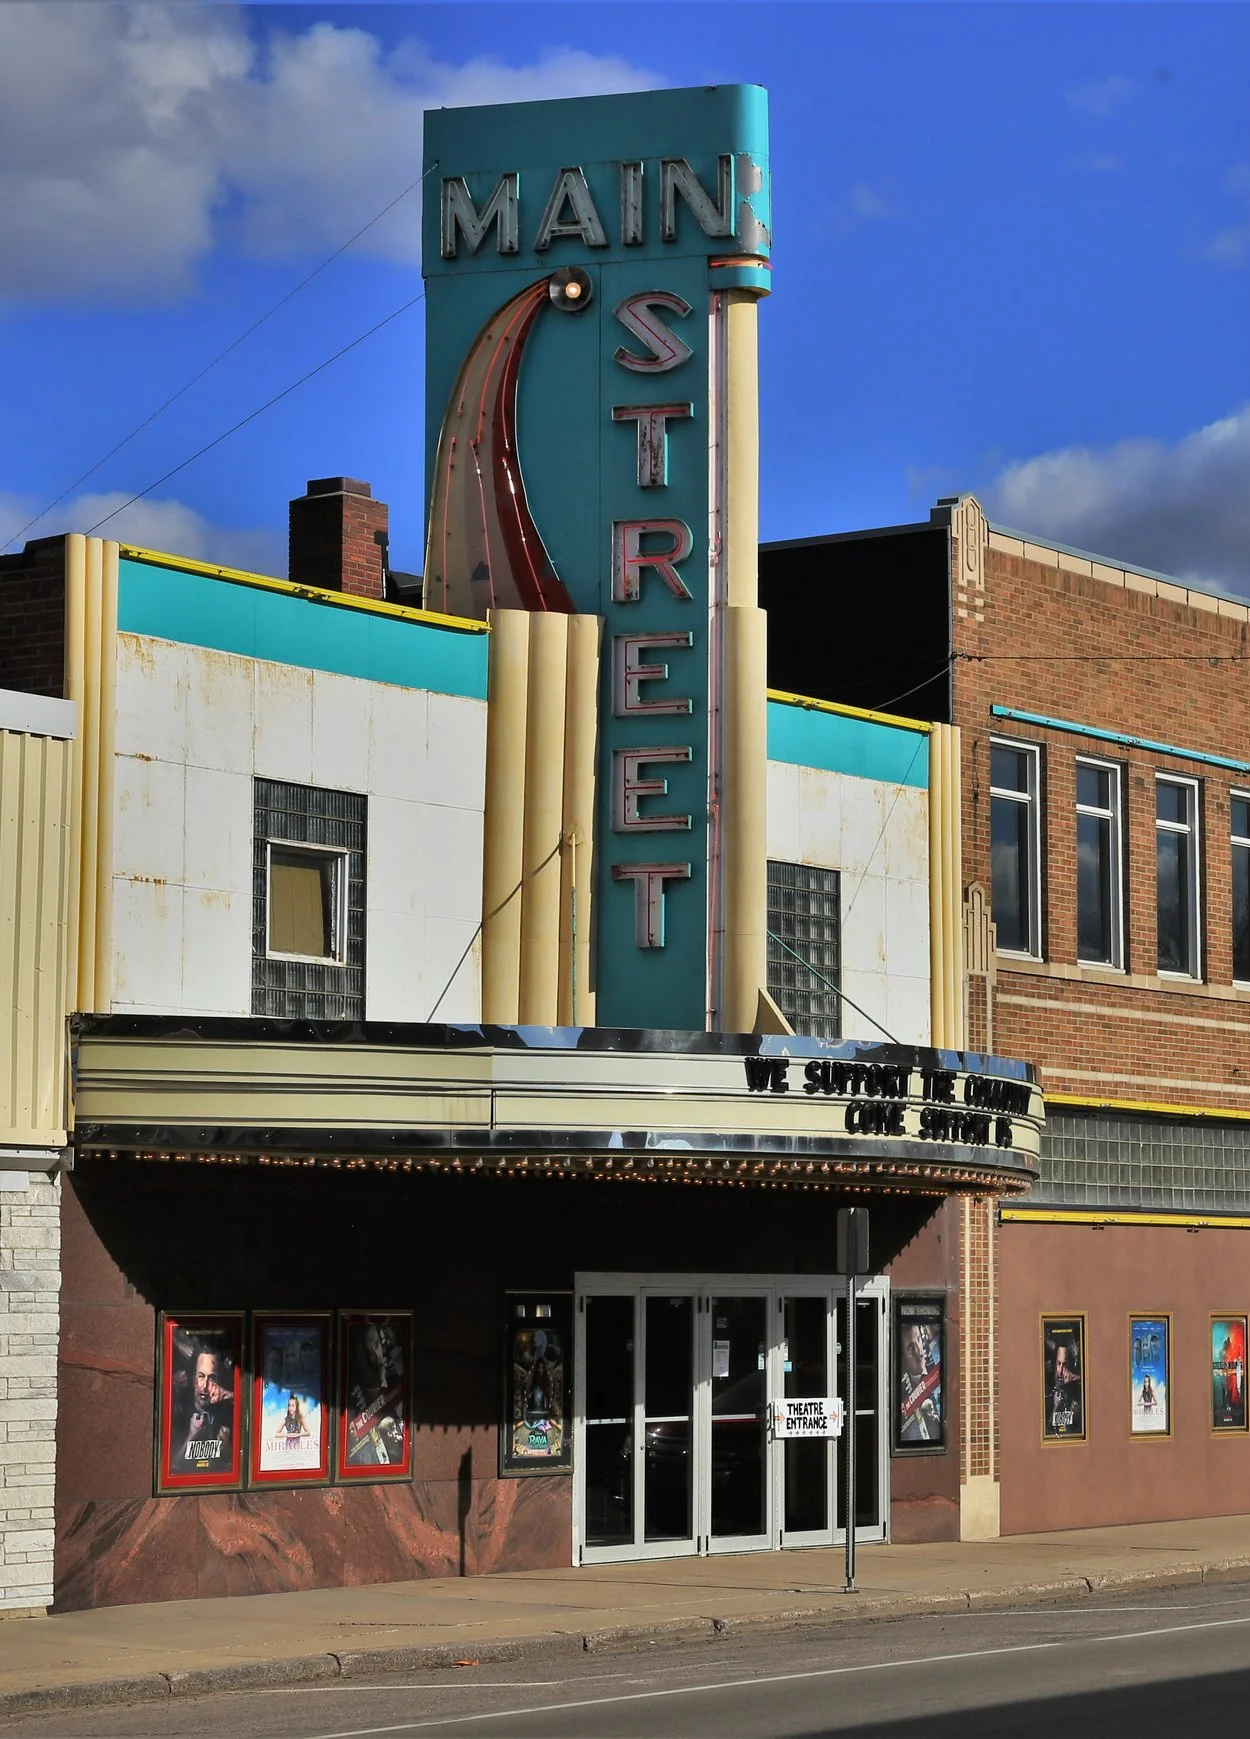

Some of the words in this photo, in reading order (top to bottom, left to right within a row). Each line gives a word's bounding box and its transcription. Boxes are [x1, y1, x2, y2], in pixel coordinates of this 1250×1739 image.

[440, 153, 736, 258] MAIN
[611, 289, 695, 949] STREET
[744, 1057, 790, 1093] WE
[803, 1060, 912, 1100] SUPPORT
[919, 1067, 957, 1104] THE
[844, 1101, 909, 1137] COME
[786, 1402, 824, 1416] THEATRE
[786, 1416, 828, 1430] ENTRANCE
[187, 1440, 221, 1459] NOBODY
[265, 1439, 319, 1452] MIRACLES
[528, 1435, 548, 1445] RAYA
